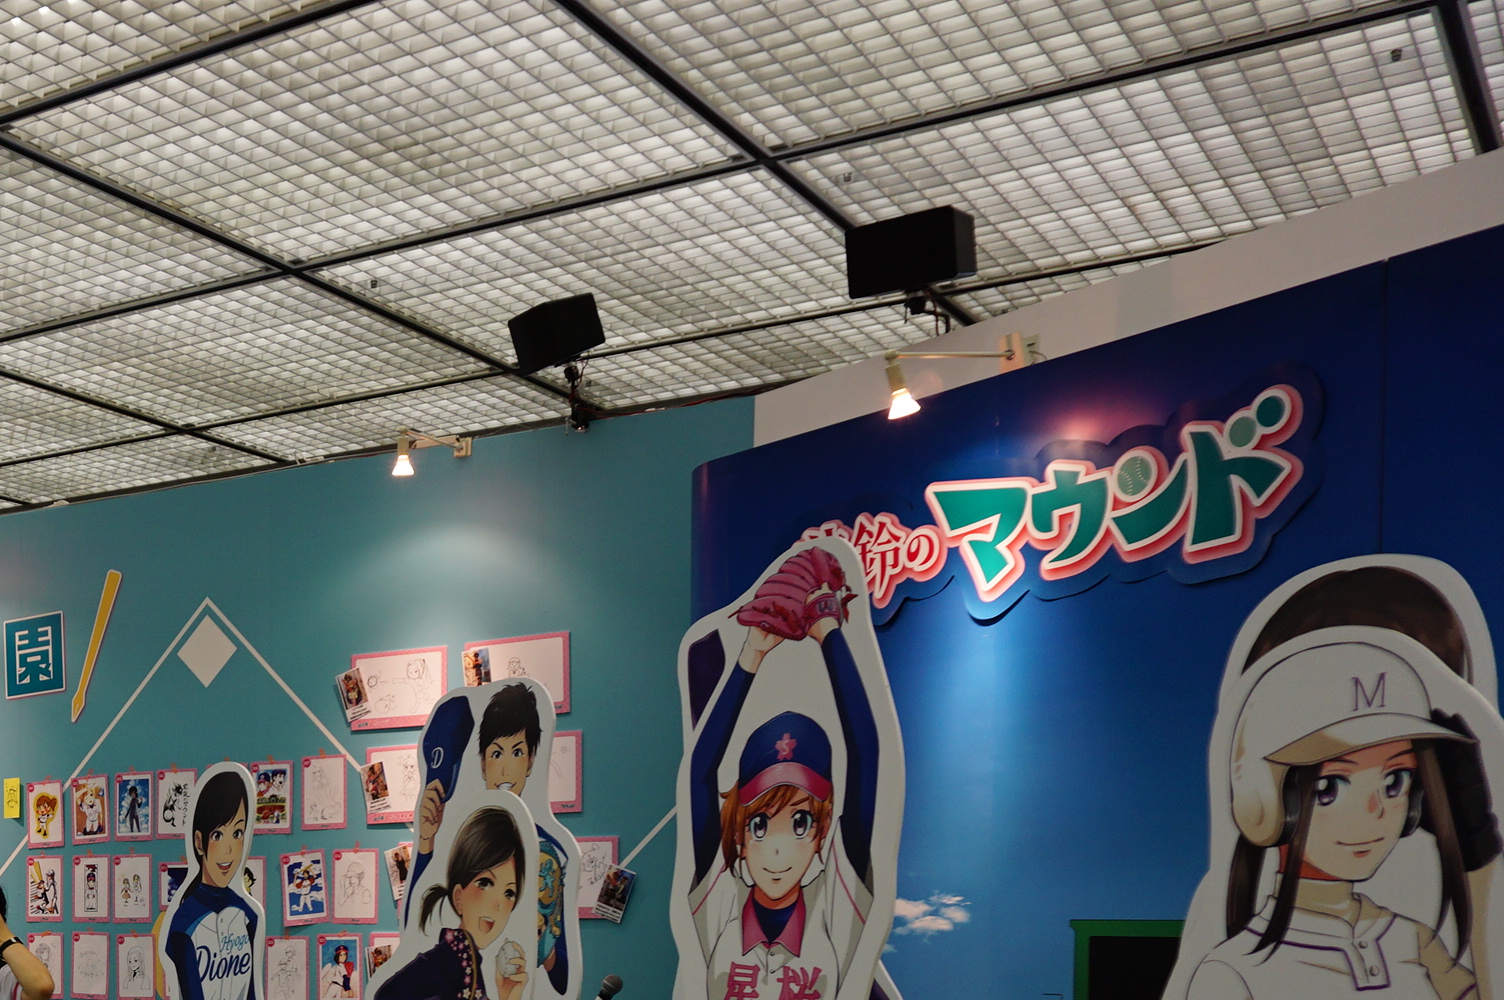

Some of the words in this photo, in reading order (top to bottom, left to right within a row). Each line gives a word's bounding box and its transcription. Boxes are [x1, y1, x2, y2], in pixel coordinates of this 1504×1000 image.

[802, 385, 1302, 609] 鈴のマウンド
[1351, 672, 1388, 712] M
[431, 747, 444, 769] D
[196, 945, 251, 981] Dione
